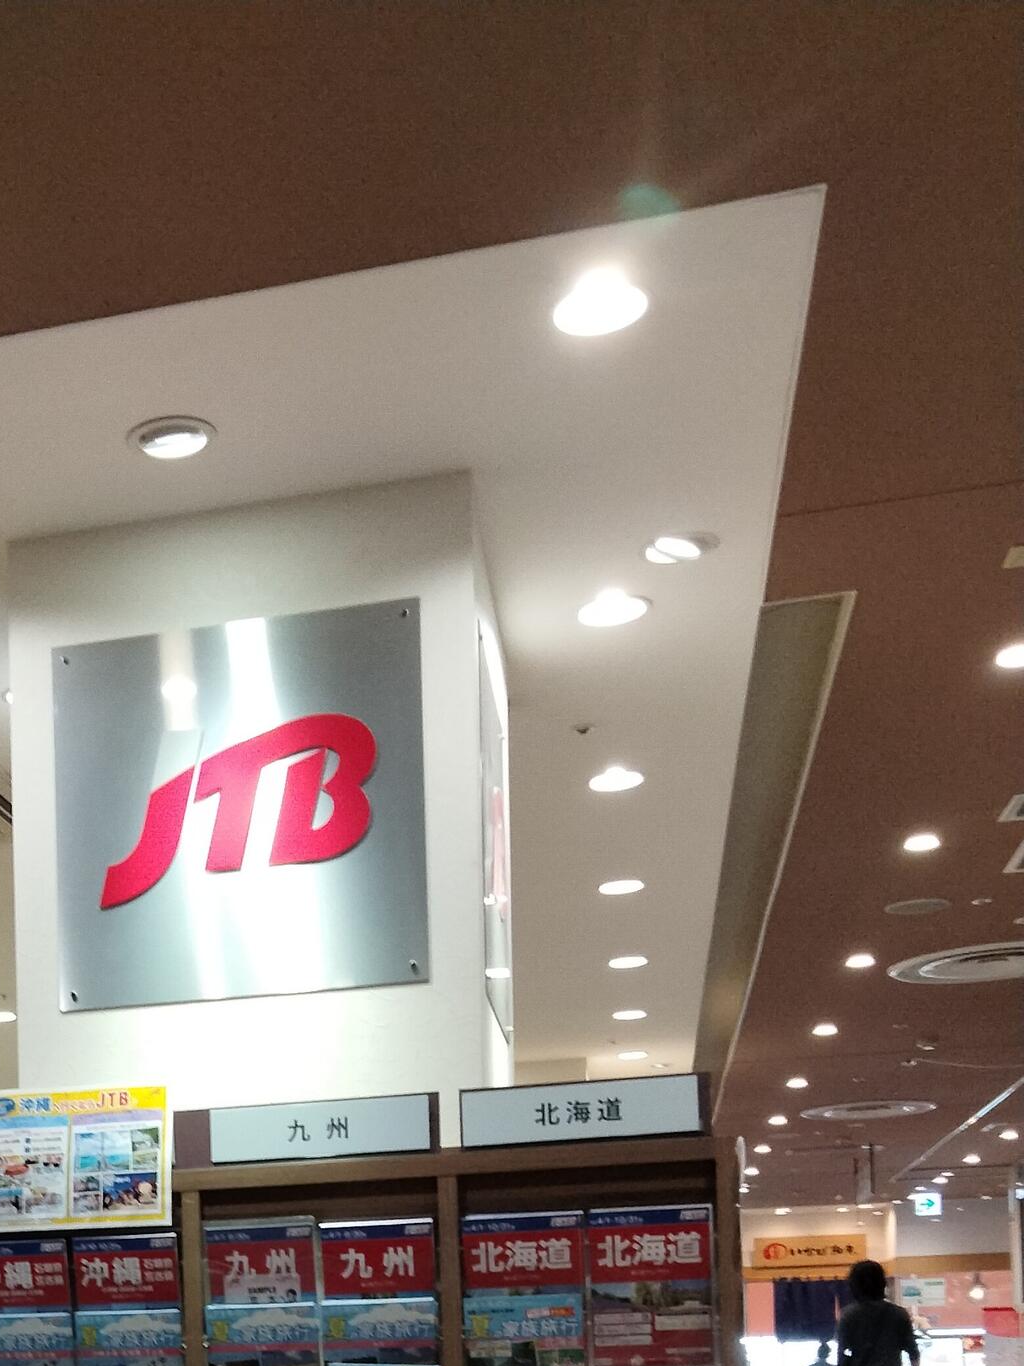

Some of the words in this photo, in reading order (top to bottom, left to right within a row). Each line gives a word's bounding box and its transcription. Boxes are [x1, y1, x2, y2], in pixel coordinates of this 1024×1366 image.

[100, 713, 377, 911] JTB
[535, 1097, 623, 1126] 北海道
[287, 1116, 350, 1143] 九州
[225, 1247, 298, 1277] 九州
[339, 1245, 416, 1279] 九州
[471, 1237, 573, 1273] 北海道
[597, 1231, 702, 1268] 北海道
[80, 1256, 143, 1288] 沖縄
